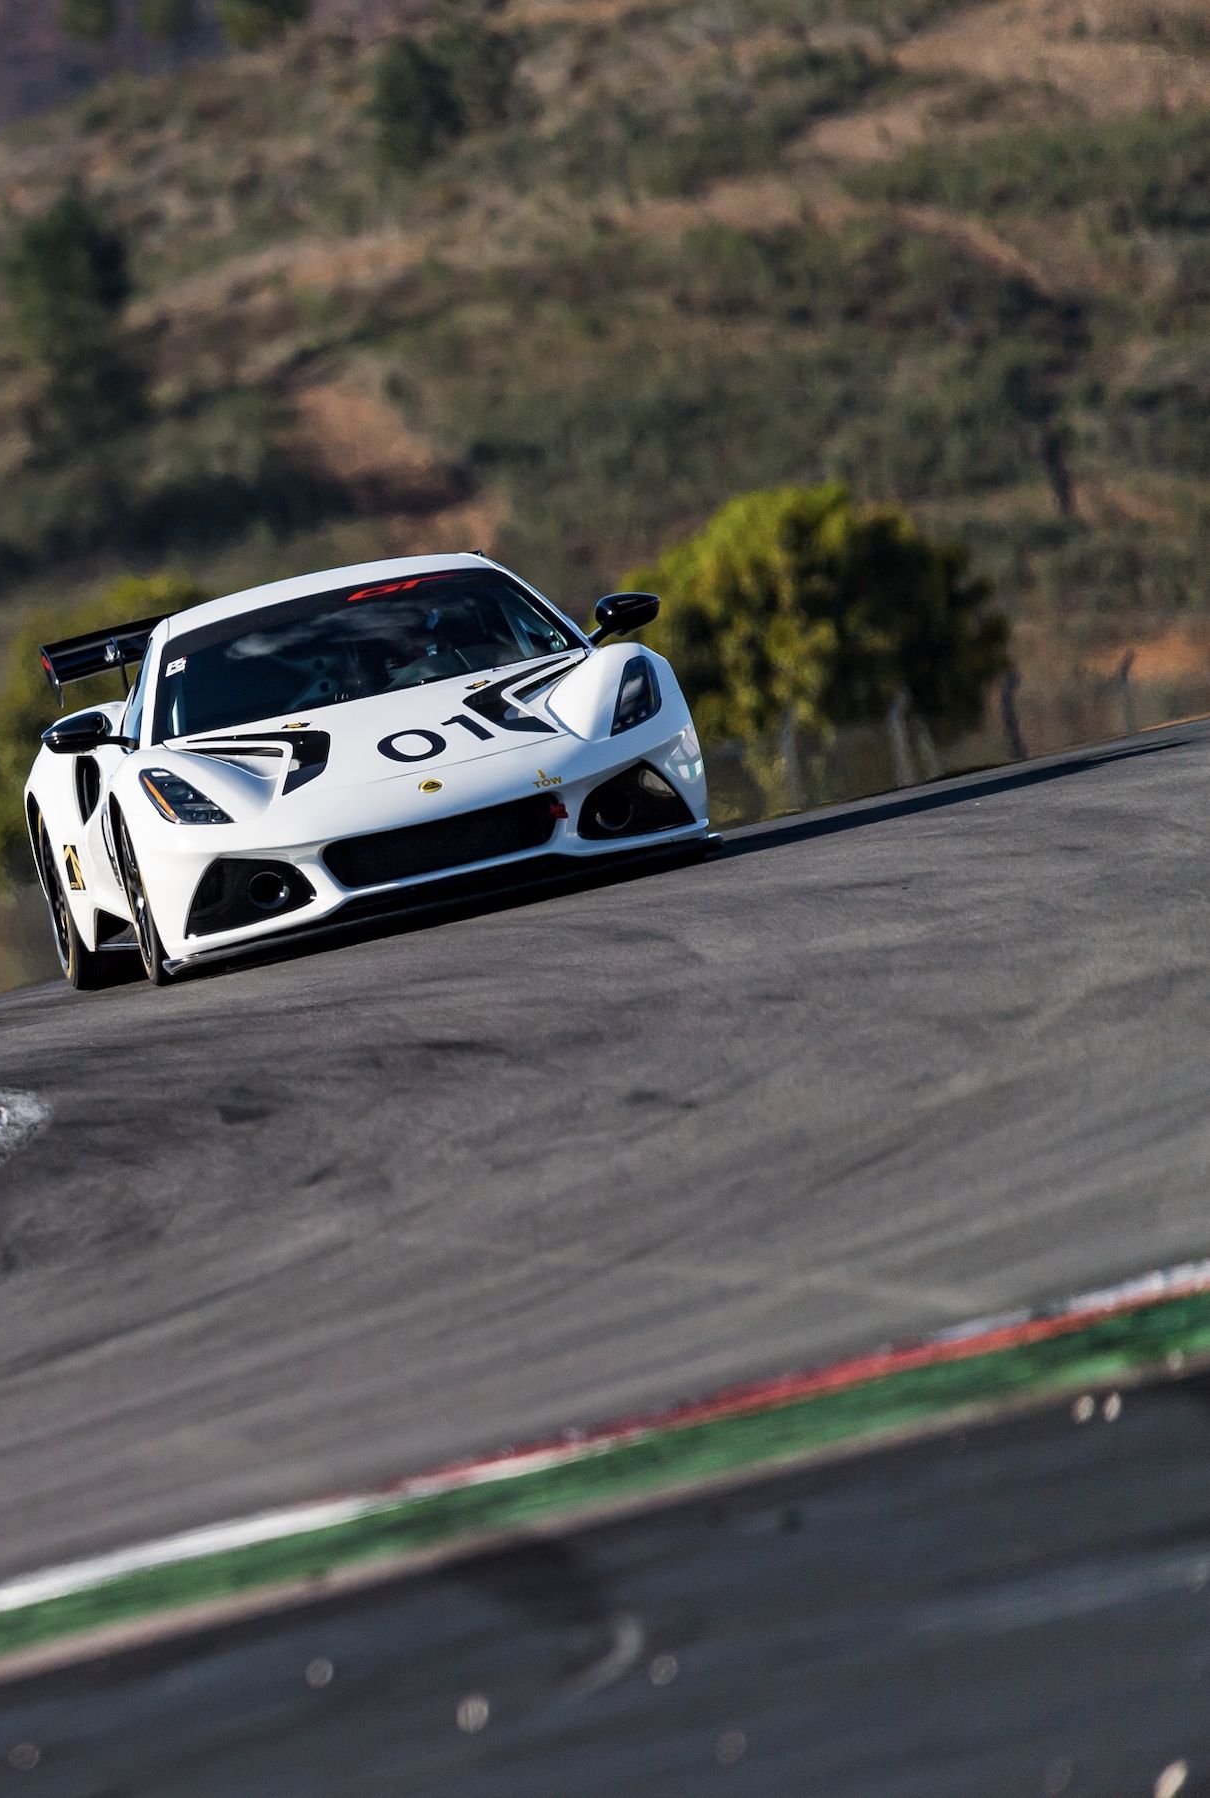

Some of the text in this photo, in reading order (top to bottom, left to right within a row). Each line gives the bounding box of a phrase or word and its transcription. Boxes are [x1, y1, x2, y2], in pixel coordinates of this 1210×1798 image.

[347, 574, 455, 601] GT
[377, 714, 494, 762] 01
[533, 775, 562, 789] TOW
